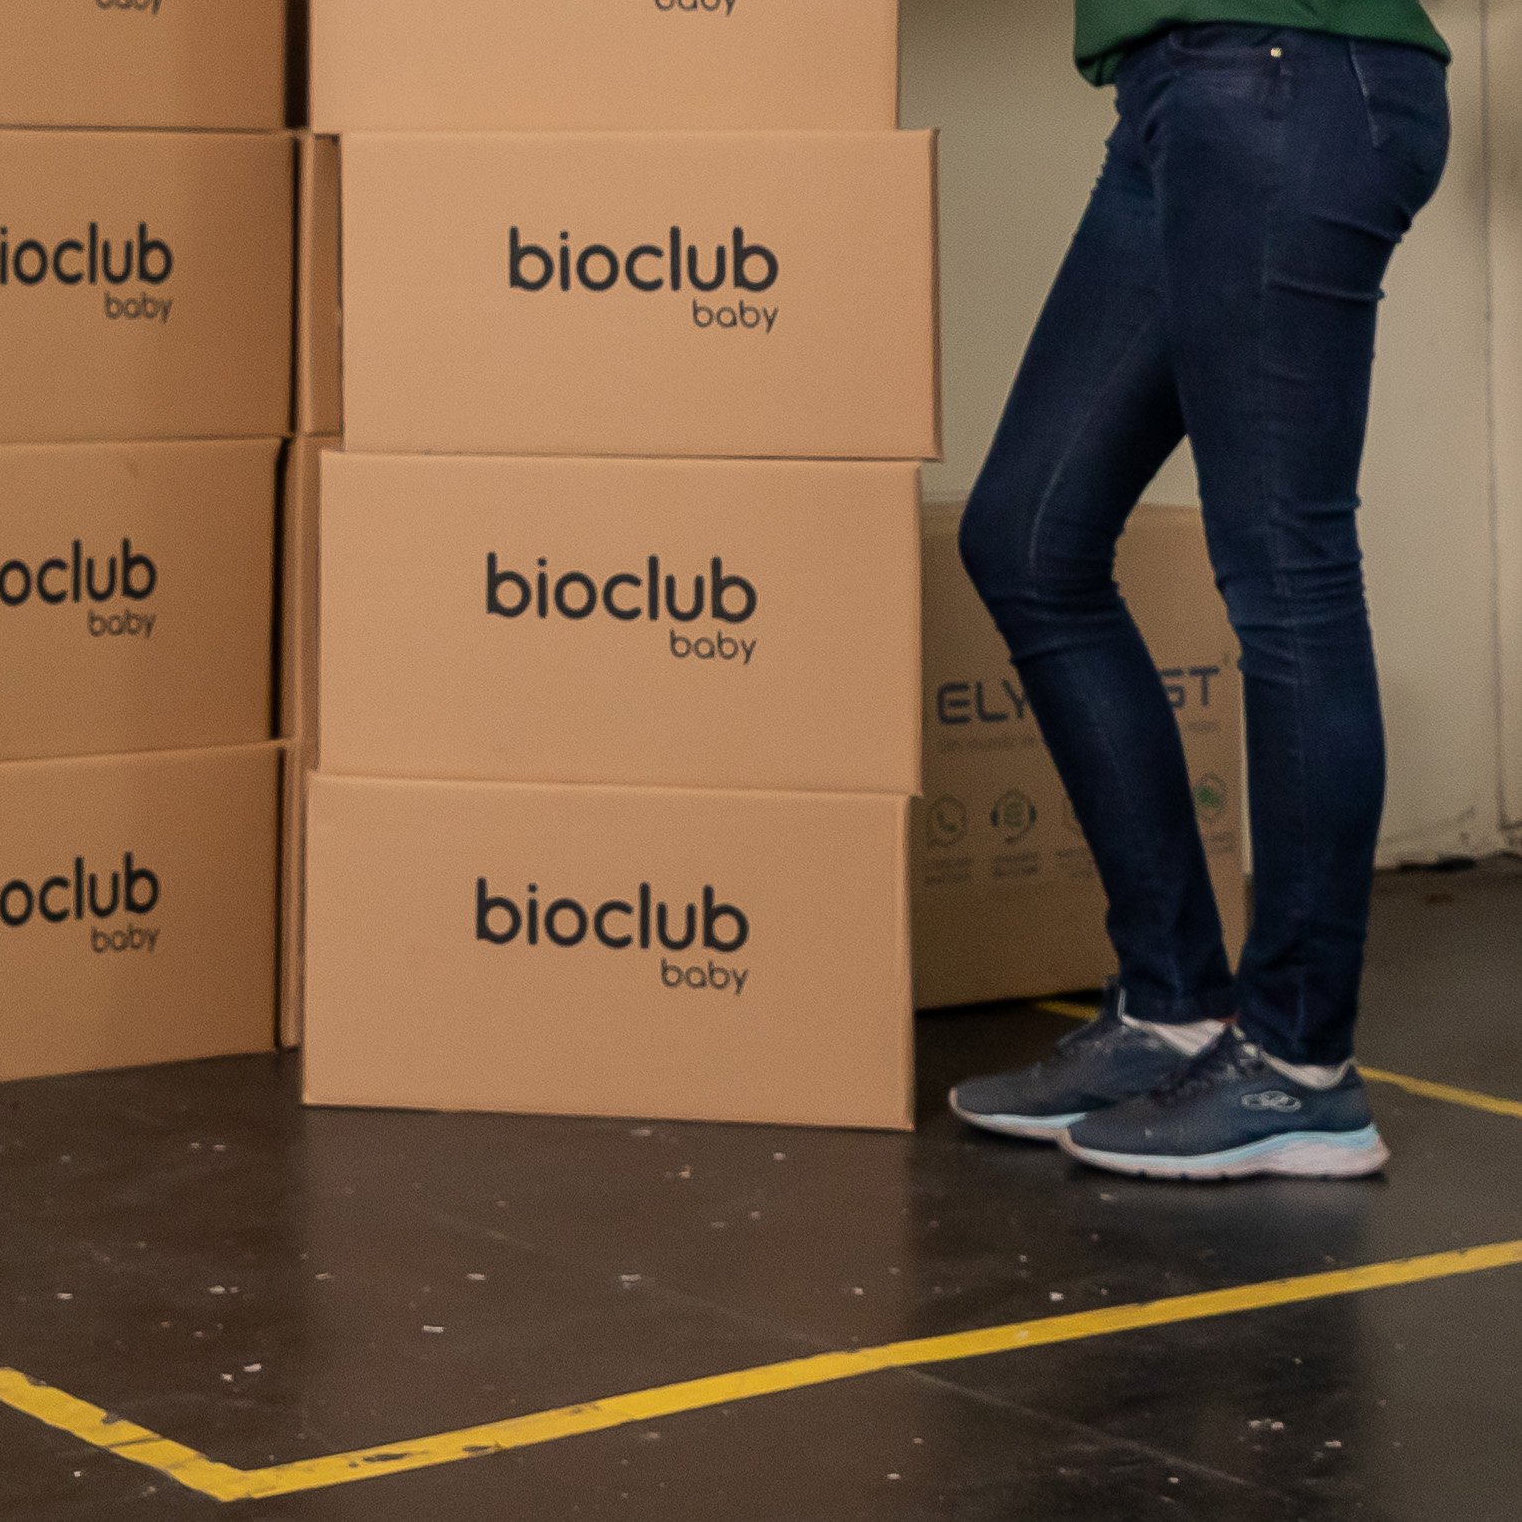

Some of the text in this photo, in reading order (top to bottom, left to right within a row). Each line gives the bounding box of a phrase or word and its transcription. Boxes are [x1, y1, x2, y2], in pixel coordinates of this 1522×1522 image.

[508, 225, 779, 294] bioclub
[104, 292, 173, 325] baby
[692, 299, 779, 334] baby
[485, 551, 758, 625] bioclub
[88, 609, 157, 638] baby
[669, 629, 757, 665] baby
[475, 877, 750, 954] bioclub
[90, 922, 161, 954] baby
[660, 957, 748, 995] baby
